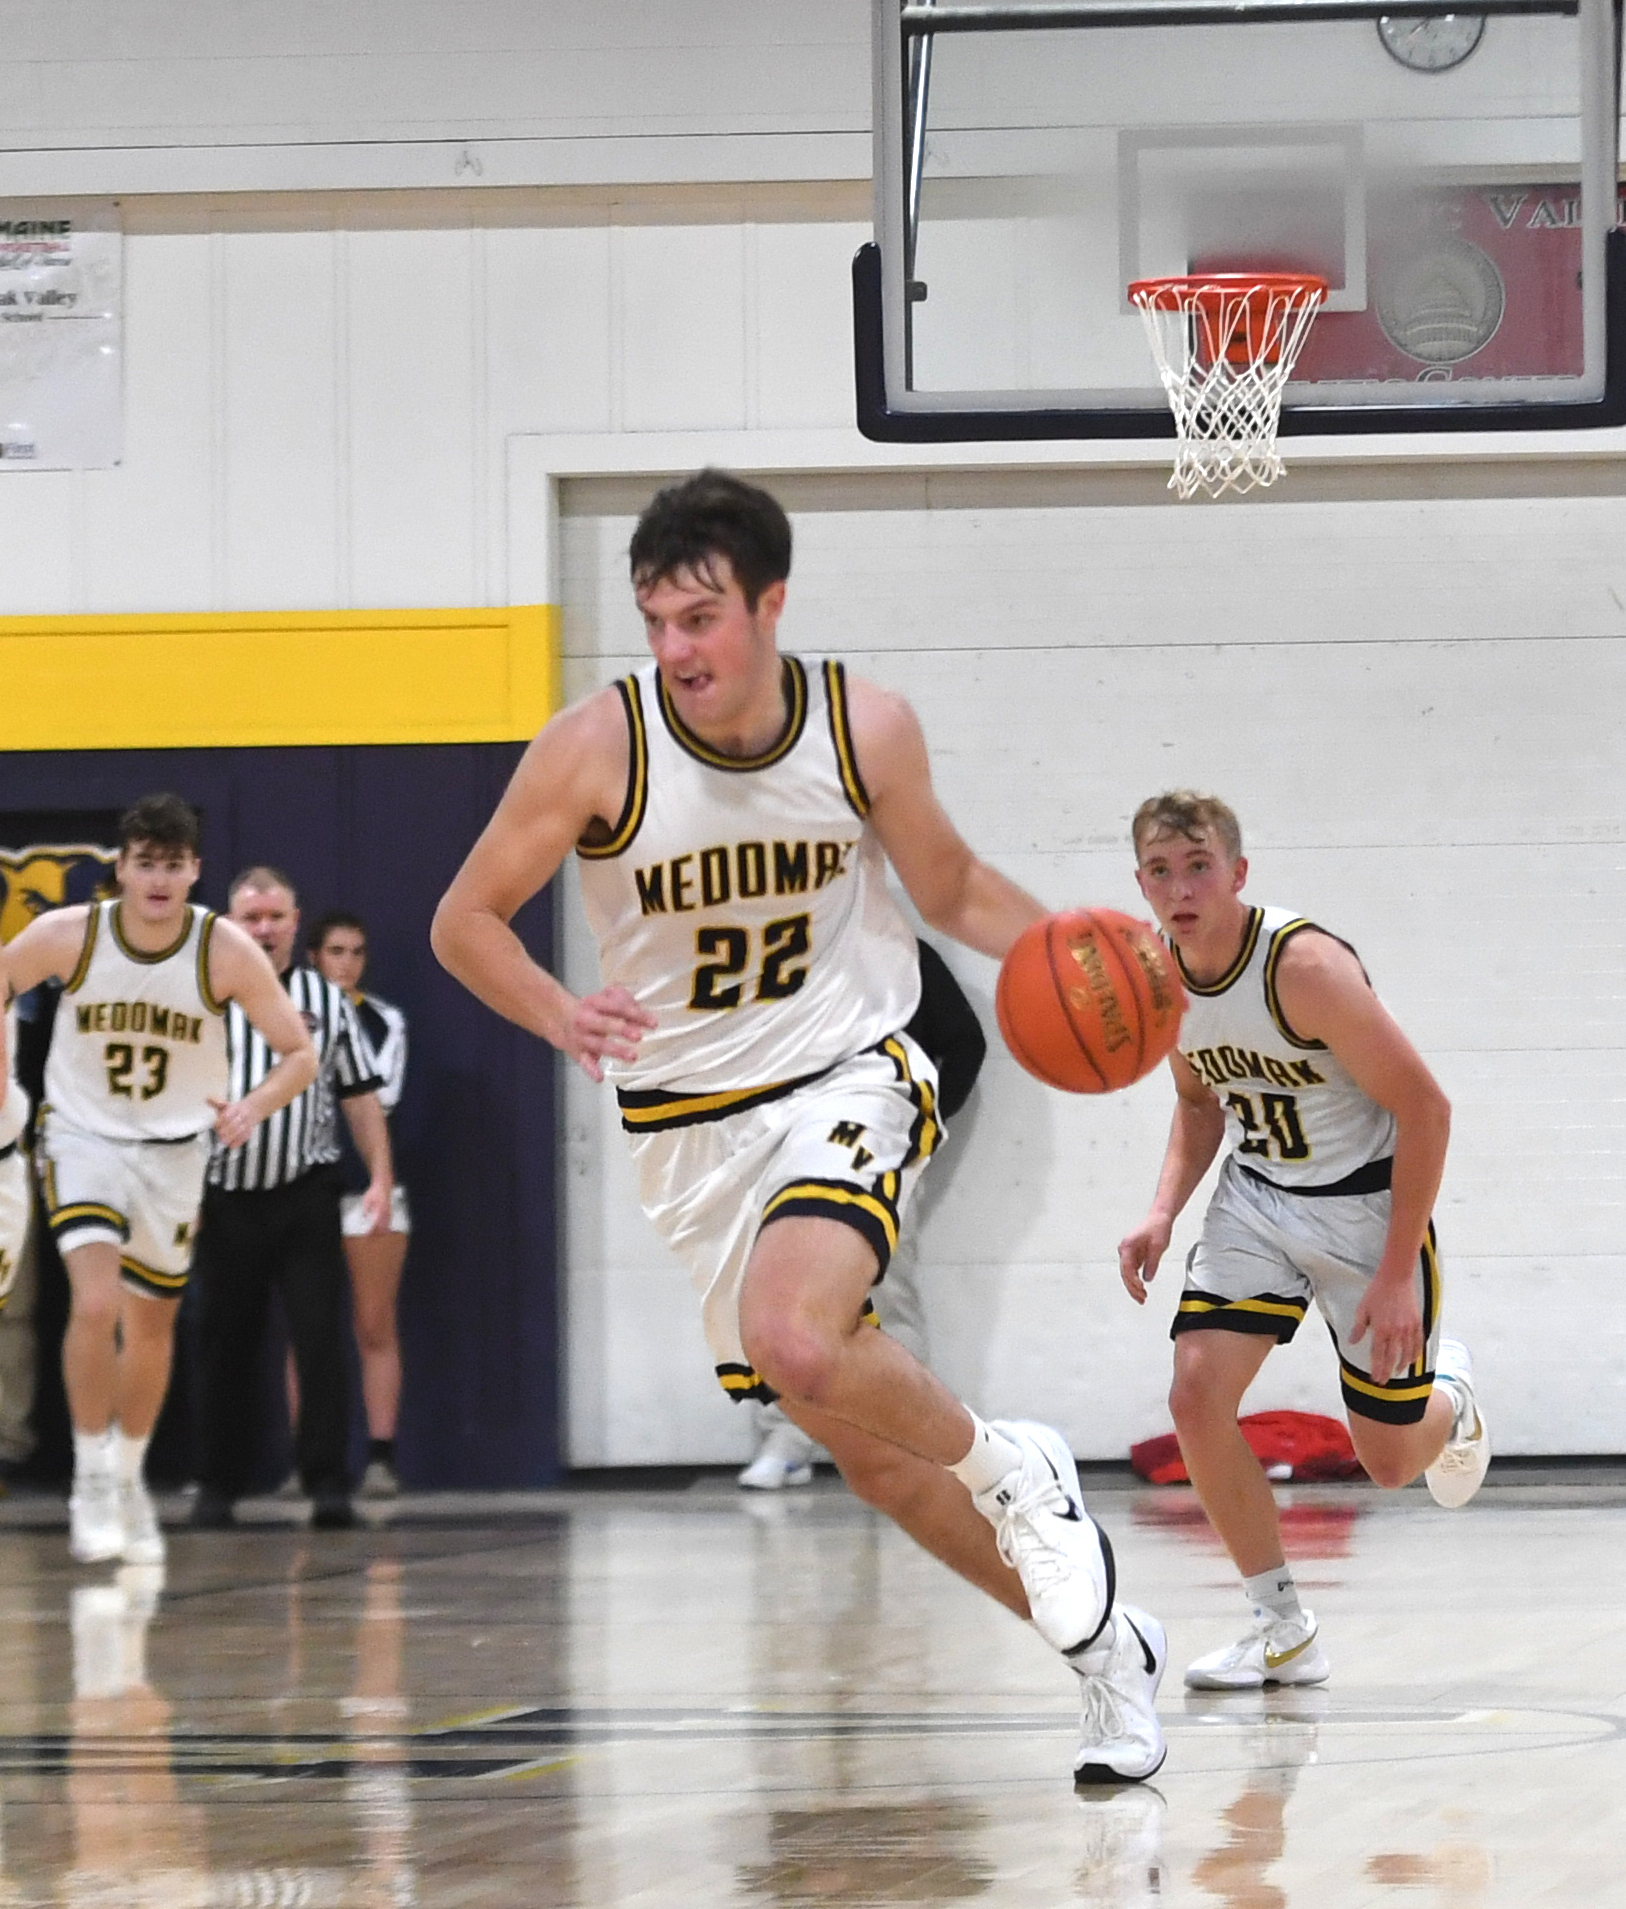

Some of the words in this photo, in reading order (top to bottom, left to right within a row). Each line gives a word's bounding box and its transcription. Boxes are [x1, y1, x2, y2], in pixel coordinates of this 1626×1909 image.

[634, 841, 854, 917] MEDOMA
[686, 911, 812, 1013] 22
[76, 1002, 202, 1044] MEDOMAK
[105, 1043, 169, 1100] 23
